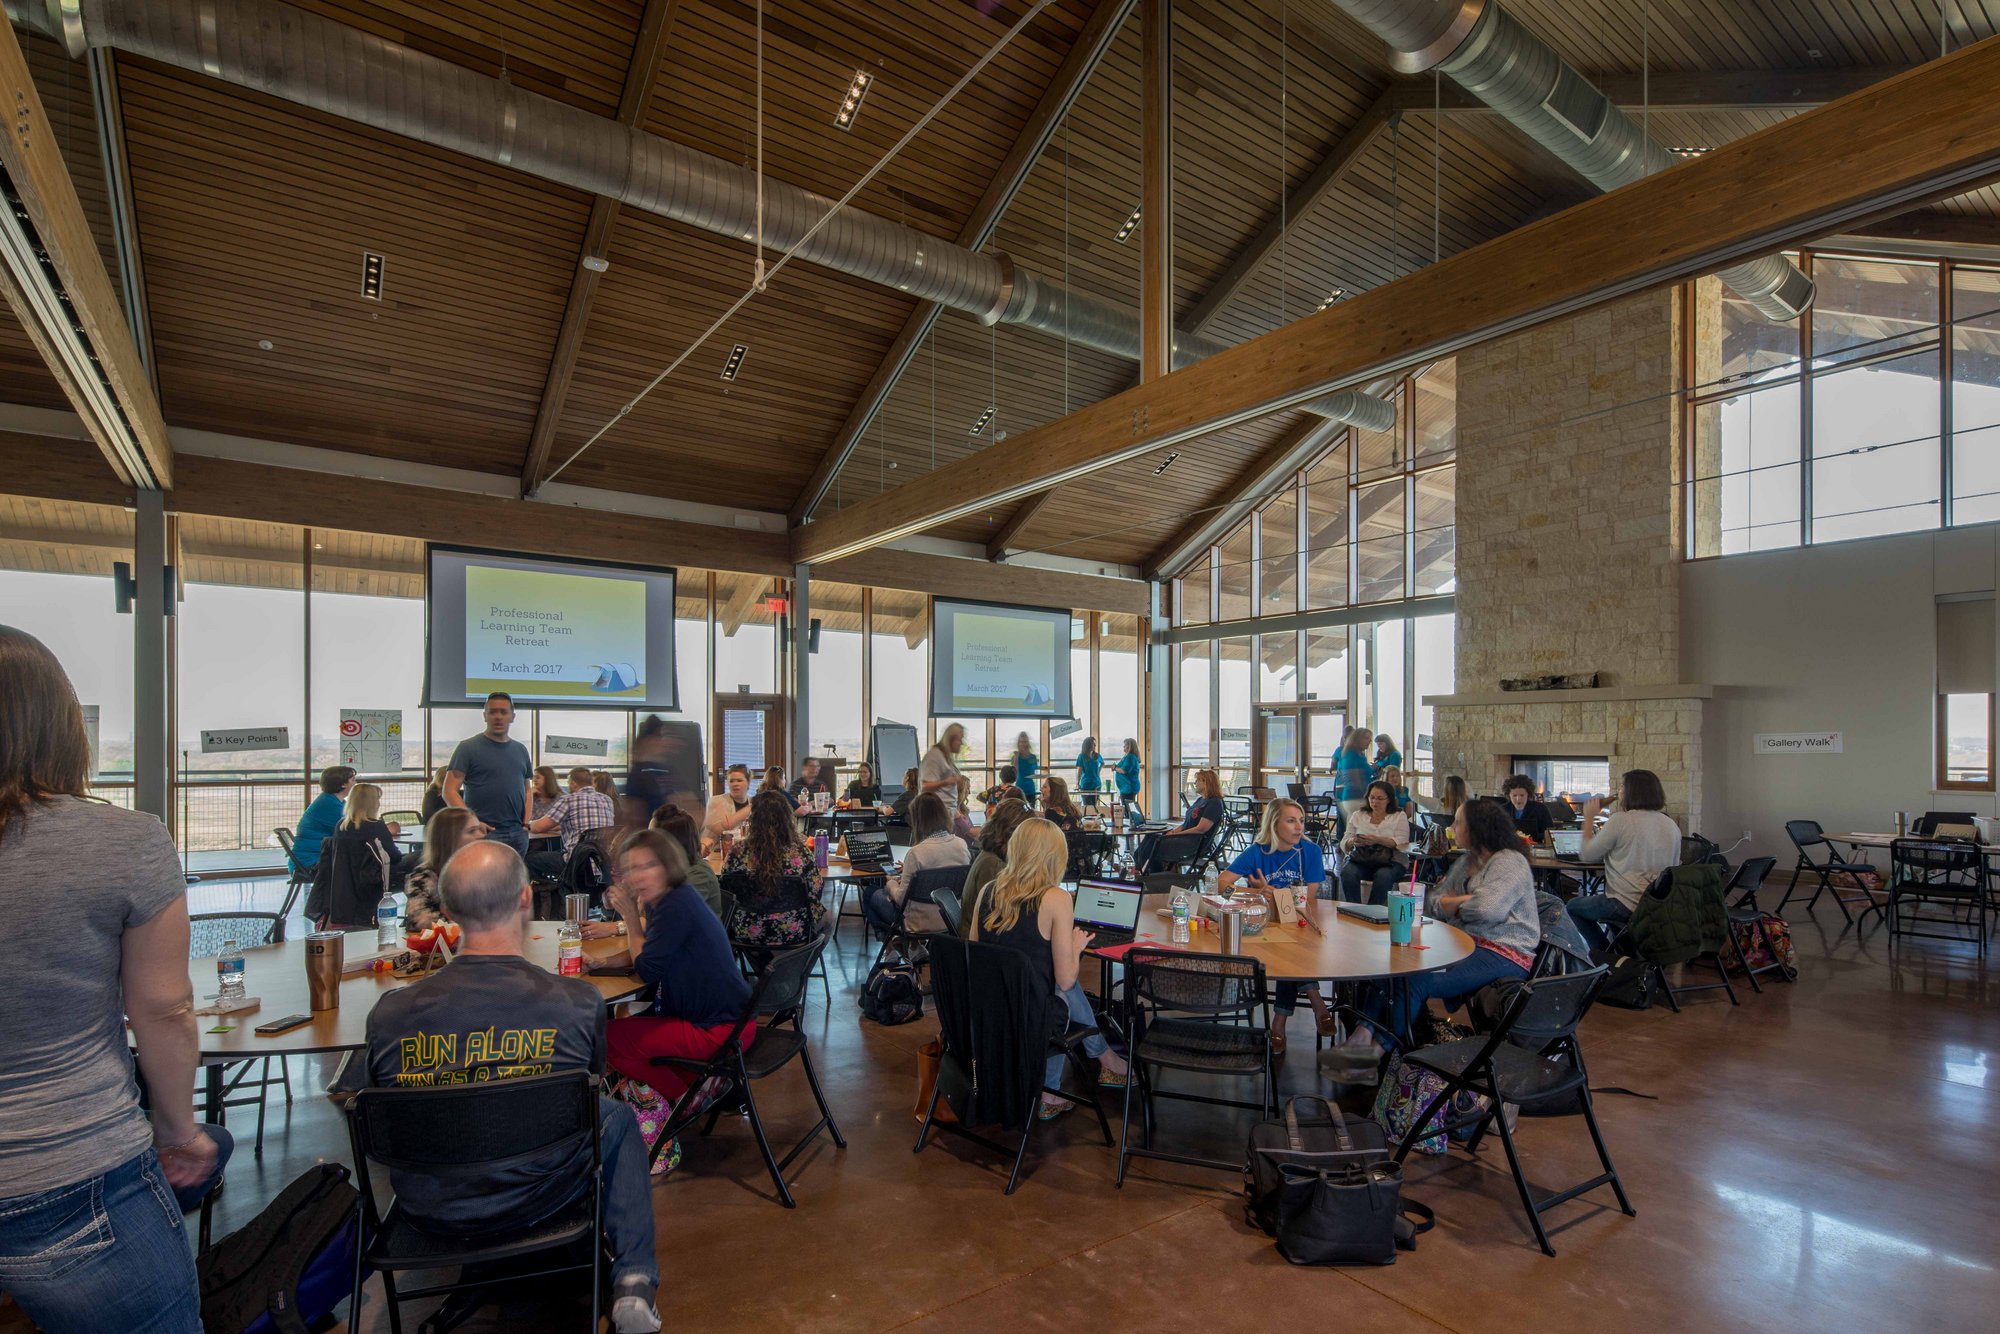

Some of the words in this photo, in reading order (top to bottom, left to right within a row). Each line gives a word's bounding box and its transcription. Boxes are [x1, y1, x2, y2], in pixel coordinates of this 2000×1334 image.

[490, 606, 563, 621] Professional
[480, 620, 535, 634] Learning
[539, 623, 572, 635] Team
[505, 635, 550, 647] Retreat
[967, 642, 1008, 653] Professional
[961, 652, 992, 663] Learning
[994, 654, 1013, 663] Team
[491, 662, 530, 673] March
[534, 663, 563, 674] 2017
[975, 663, 1000, 672] Retreat
[967, 684, 989, 692] March
[990, 685, 1008, 693] 2017
[216, 737, 223, 745] 3
[225, 736, 245, 746] Key
[247, 735, 278, 743] Points
[566, 742, 589, 750] ABC's
[1768, 739, 1803, 748] Gallery
[1804, 738, 1831, 746] Walk
[1280, 893, 1292, 915] 6
[401, 1031, 457, 1072] RUN
[465, 1026, 558, 1068] ALONE
